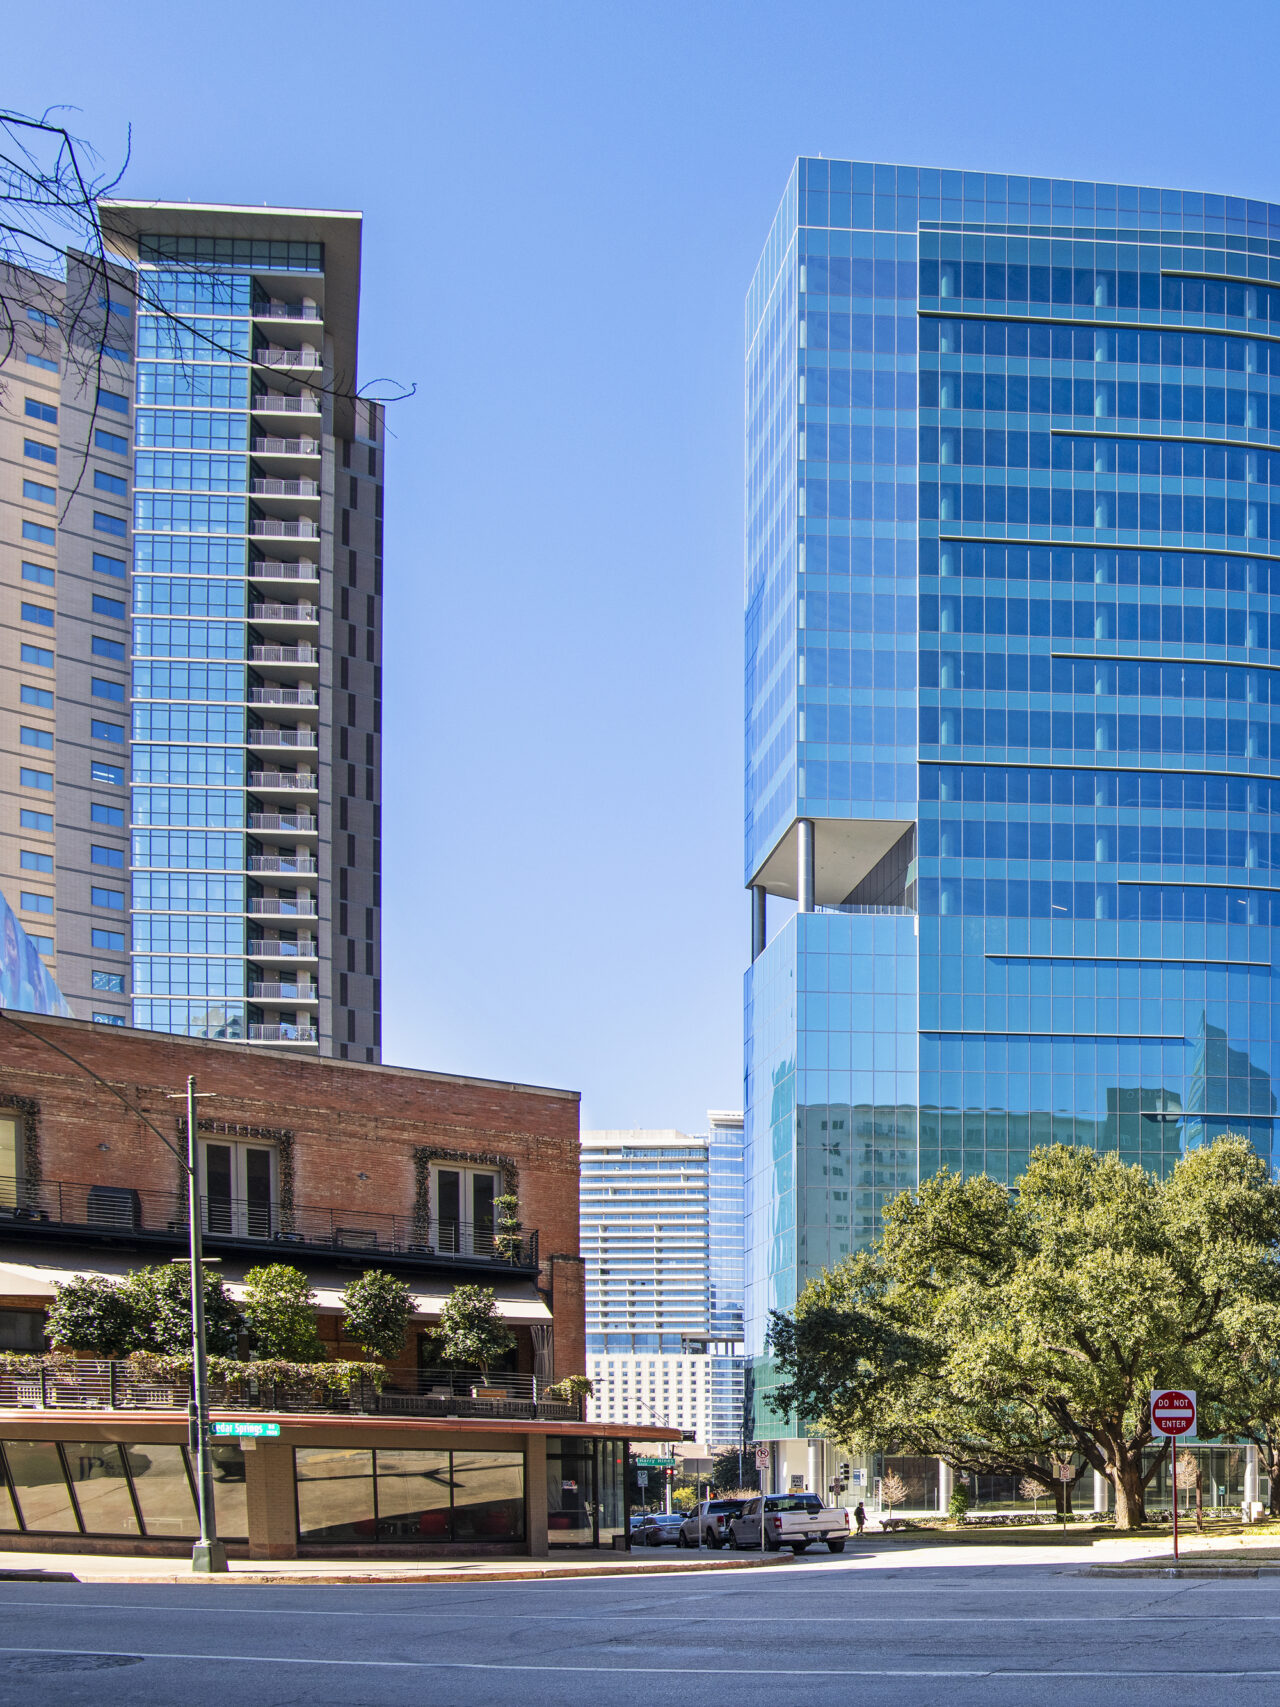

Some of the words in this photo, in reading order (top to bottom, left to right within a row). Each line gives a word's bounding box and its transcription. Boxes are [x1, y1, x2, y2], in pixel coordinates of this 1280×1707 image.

[1158, 1399, 1169, 1407] DO
[1173, 1399, 1189, 1407] NOT
[1161, 1420, 1186, 1428] ENTER
[211, 1423, 233, 1432] Cedar
[234, 1423, 263, 1436] Springs
